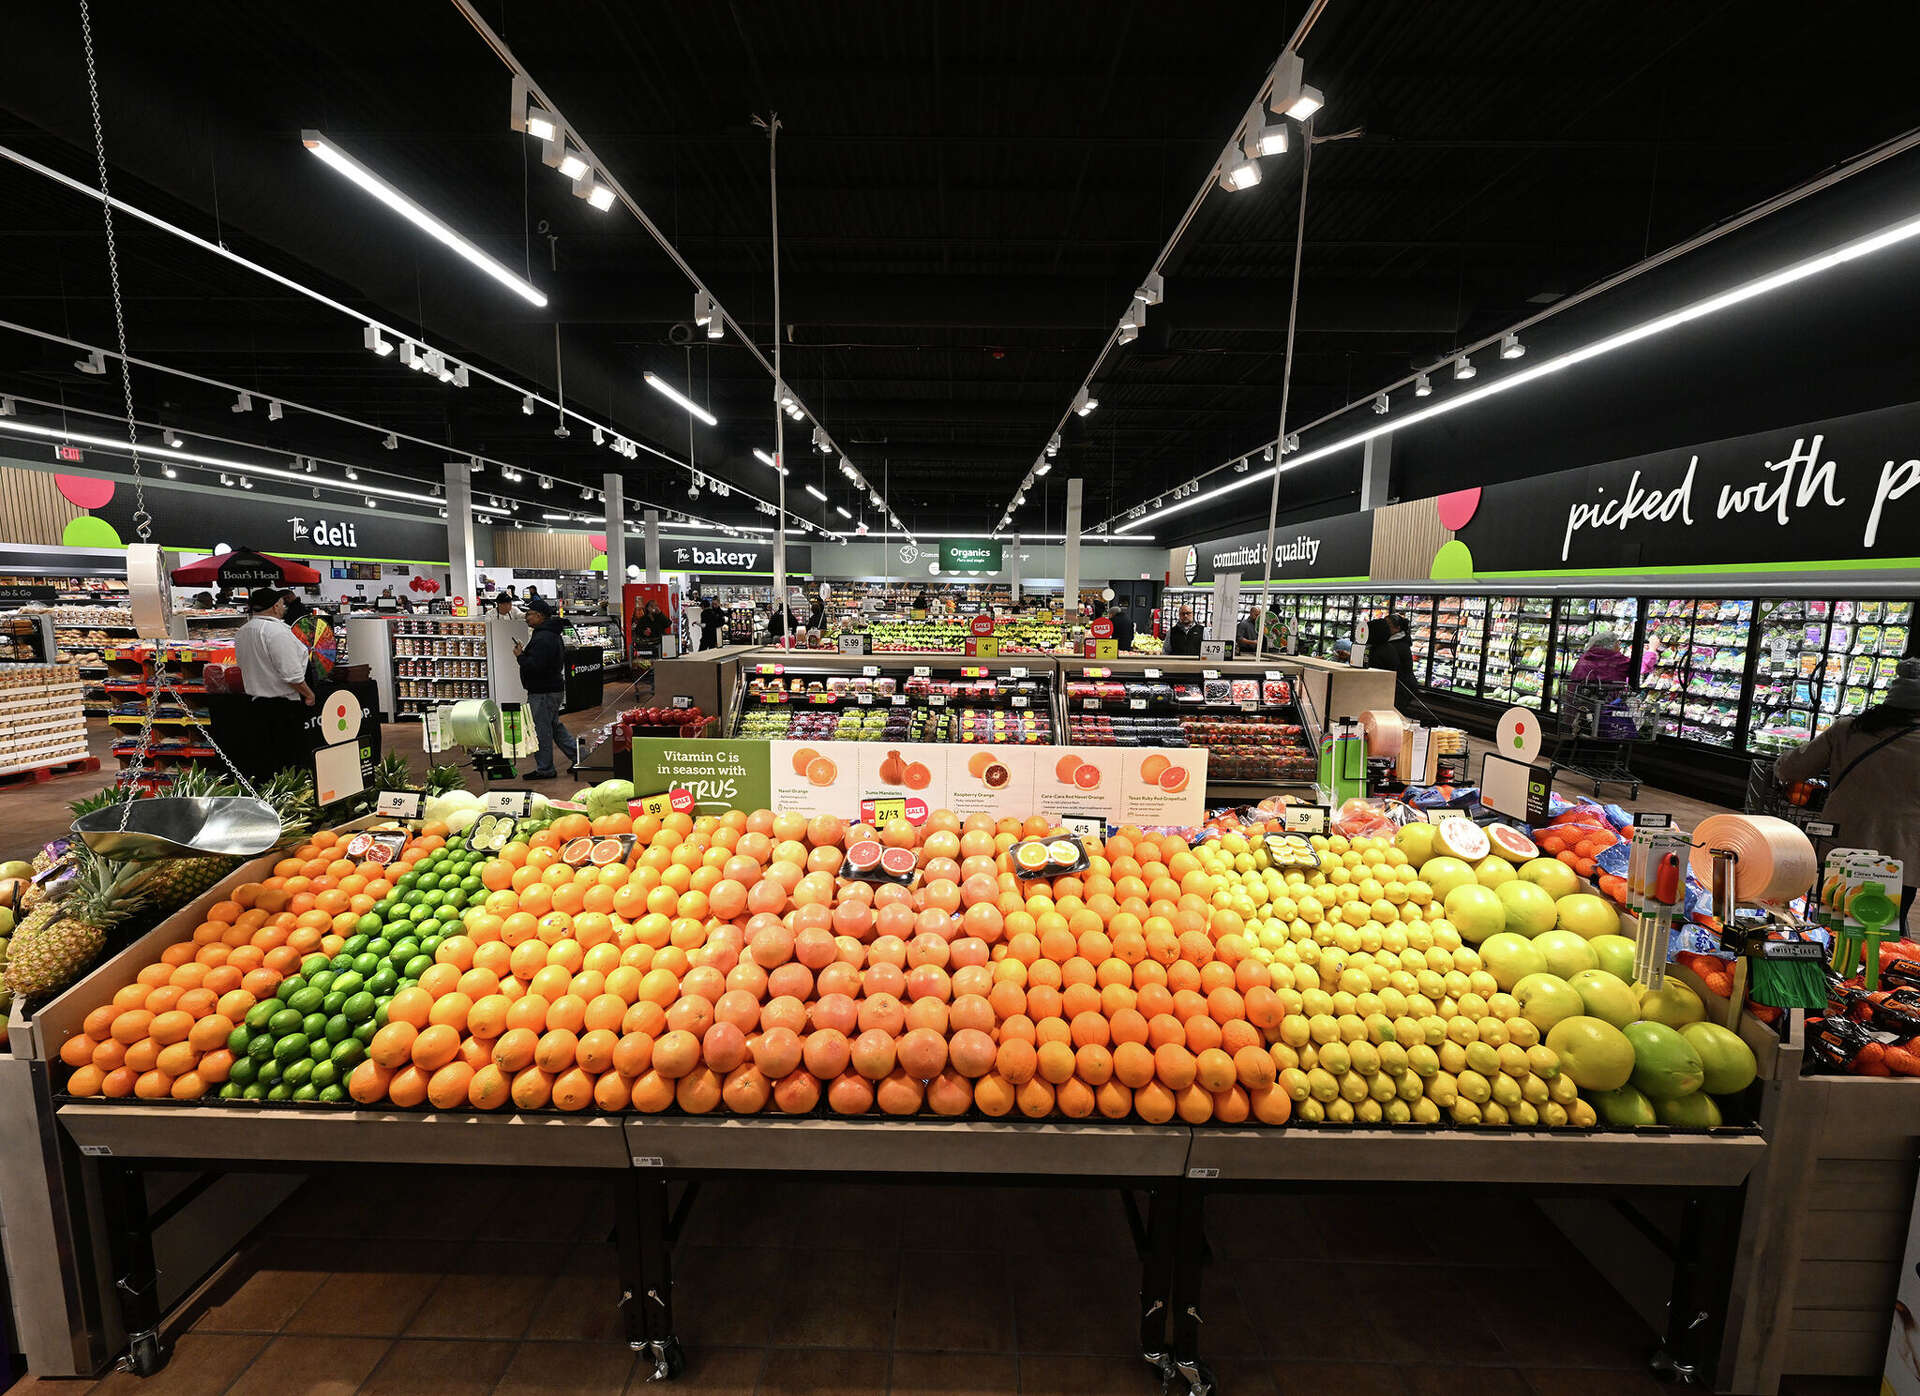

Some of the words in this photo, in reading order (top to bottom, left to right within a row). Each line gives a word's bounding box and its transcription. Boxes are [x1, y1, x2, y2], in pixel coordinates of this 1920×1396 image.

[63, 446, 80, 460] EXIT
[1561, 455, 1698, 562] picked
[1717, 434, 1846, 526] with
[286, 516, 310, 541] The
[313, 520, 357, 547] deli
[673, 548, 690, 564] The
[692, 547, 758, 570] bakery
[950, 548, 990, 558] Organics
[1213, 546, 1260, 568] committed
[1262, 546, 1272, 563] t
[1275, 536, 1320, 568] quality
[224, 570, 252, 579] Boar's
[254, 570, 279, 579] Head
[664, 751, 713, 762] Vitamin
[716, 752, 726, 762] C
[728, 752, 739, 763] is
[658, 764, 670, 774] in
[673, 766, 714, 775] season
[718, 765, 746, 776] with
[674, 797, 690, 806] SALE
